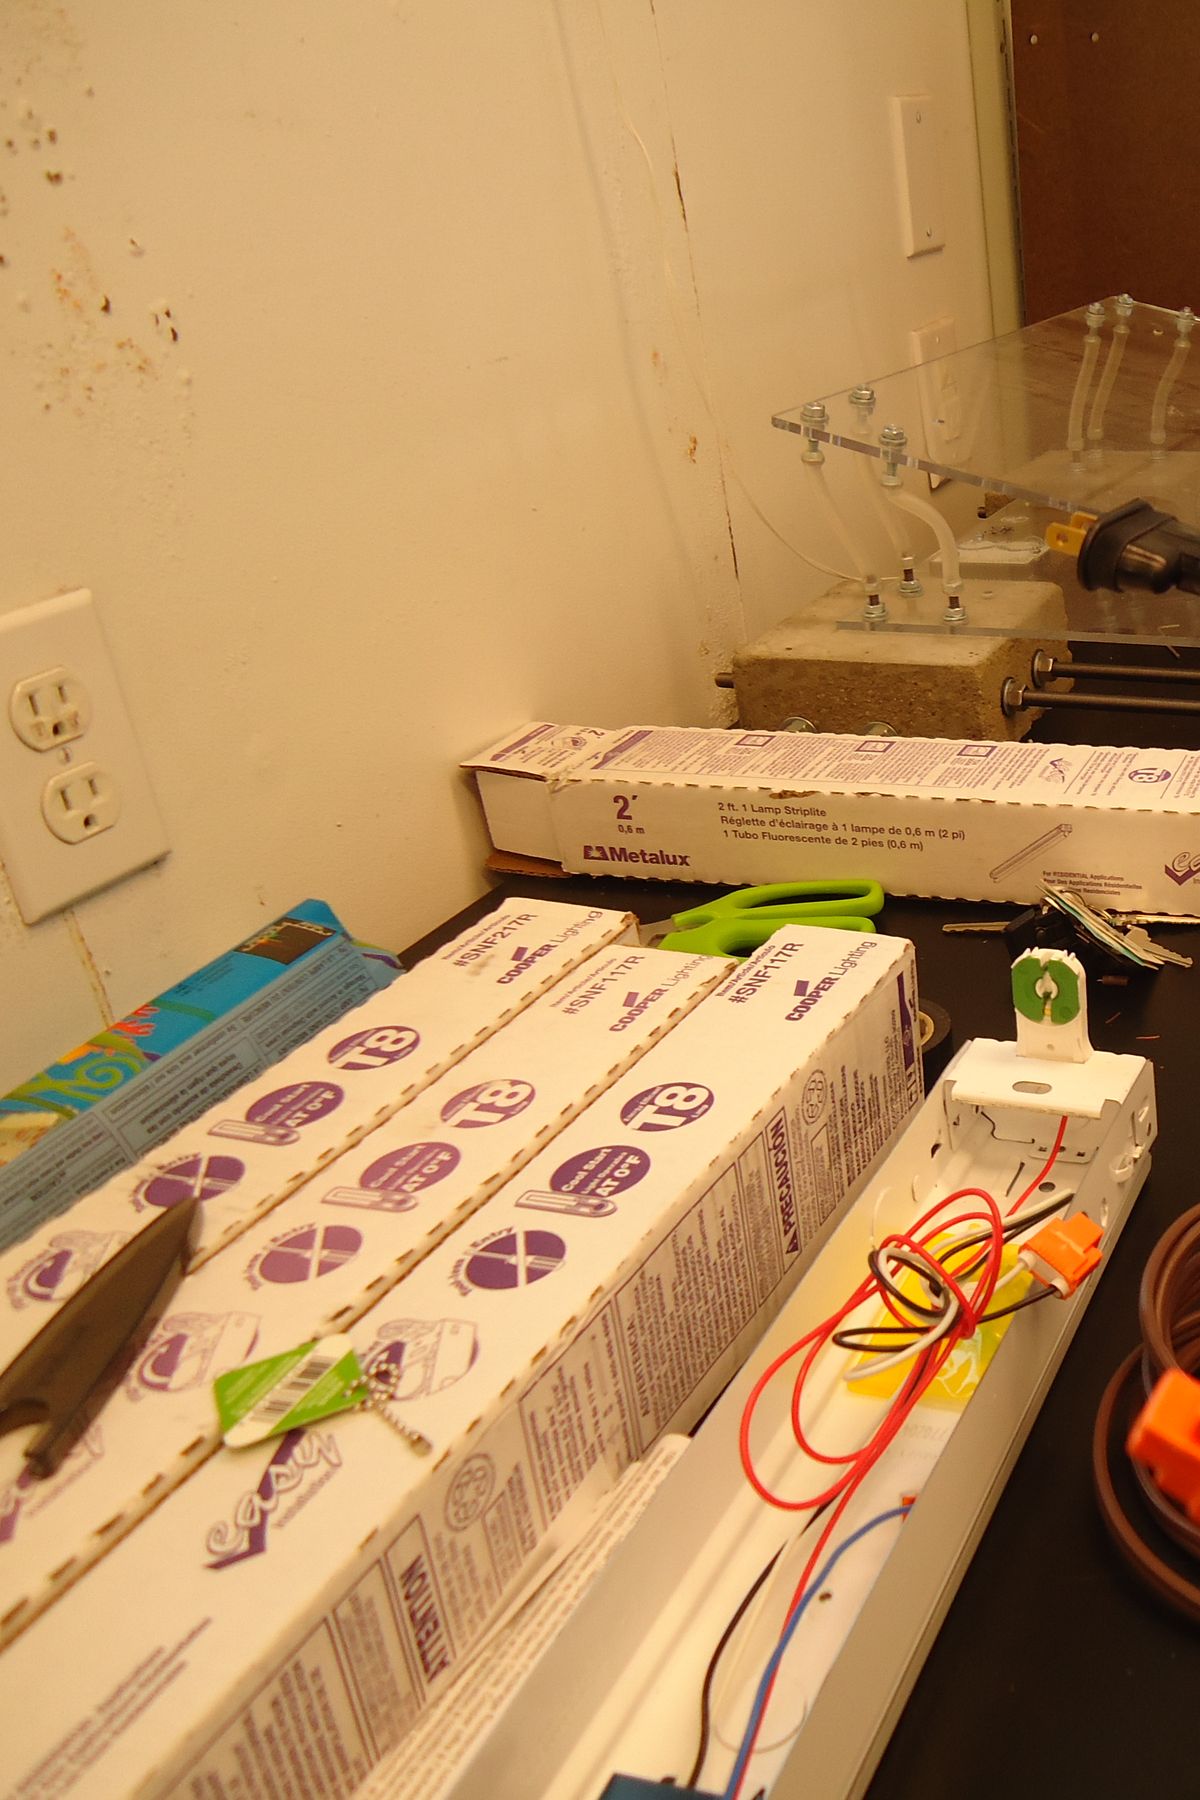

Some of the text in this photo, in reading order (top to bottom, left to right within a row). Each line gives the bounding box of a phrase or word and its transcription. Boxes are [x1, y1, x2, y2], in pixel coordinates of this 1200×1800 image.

[618, 825, 633, 834] 0,6
[718, 802, 827, 817] 2 ft. 1 Lamp Striplite
[720, 816, 766, 827] Réglette
[769, 819, 829, 832] d'éclairage
[832, 822, 839, 831] à
[851, 824, 885, 837] lampe
[888, 826, 901, 835] de
[905, 827, 922, 837] 0,6
[925, 829, 935, 837] m
[938, 829, 949, 839] (2
[951, 829, 966, 841] pi)
[609, 847, 691, 866] Metalux
[723, 830, 924, 851] 1 Tubo Fluorescente de 2 pies (0,6 m)
[453, 913, 538, 967] #SNF217R
[496, 911, 603, 984] COOPER Lighting
[562, 955, 645, 1015] #SNF117R
[609, 954, 713, 1032] COOPER Lighting
[728, 943, 804, 1004] #SNF117R
[785, 941, 877, 1021] COOPER Lighting
[333, 1029, 416, 1068] T8
[447, 1080, 532, 1126] T8
[626, 1086, 709, 1130] T8
[561, 1148, 612, 1191] Cool Start
[596, 1178, 620, 1196] AT
[768, 1117, 795, 1237] PRECAUCIÓN
[206, 1430, 342, 1556] easy
[399, 1554, 450, 1684] ATTENTION
